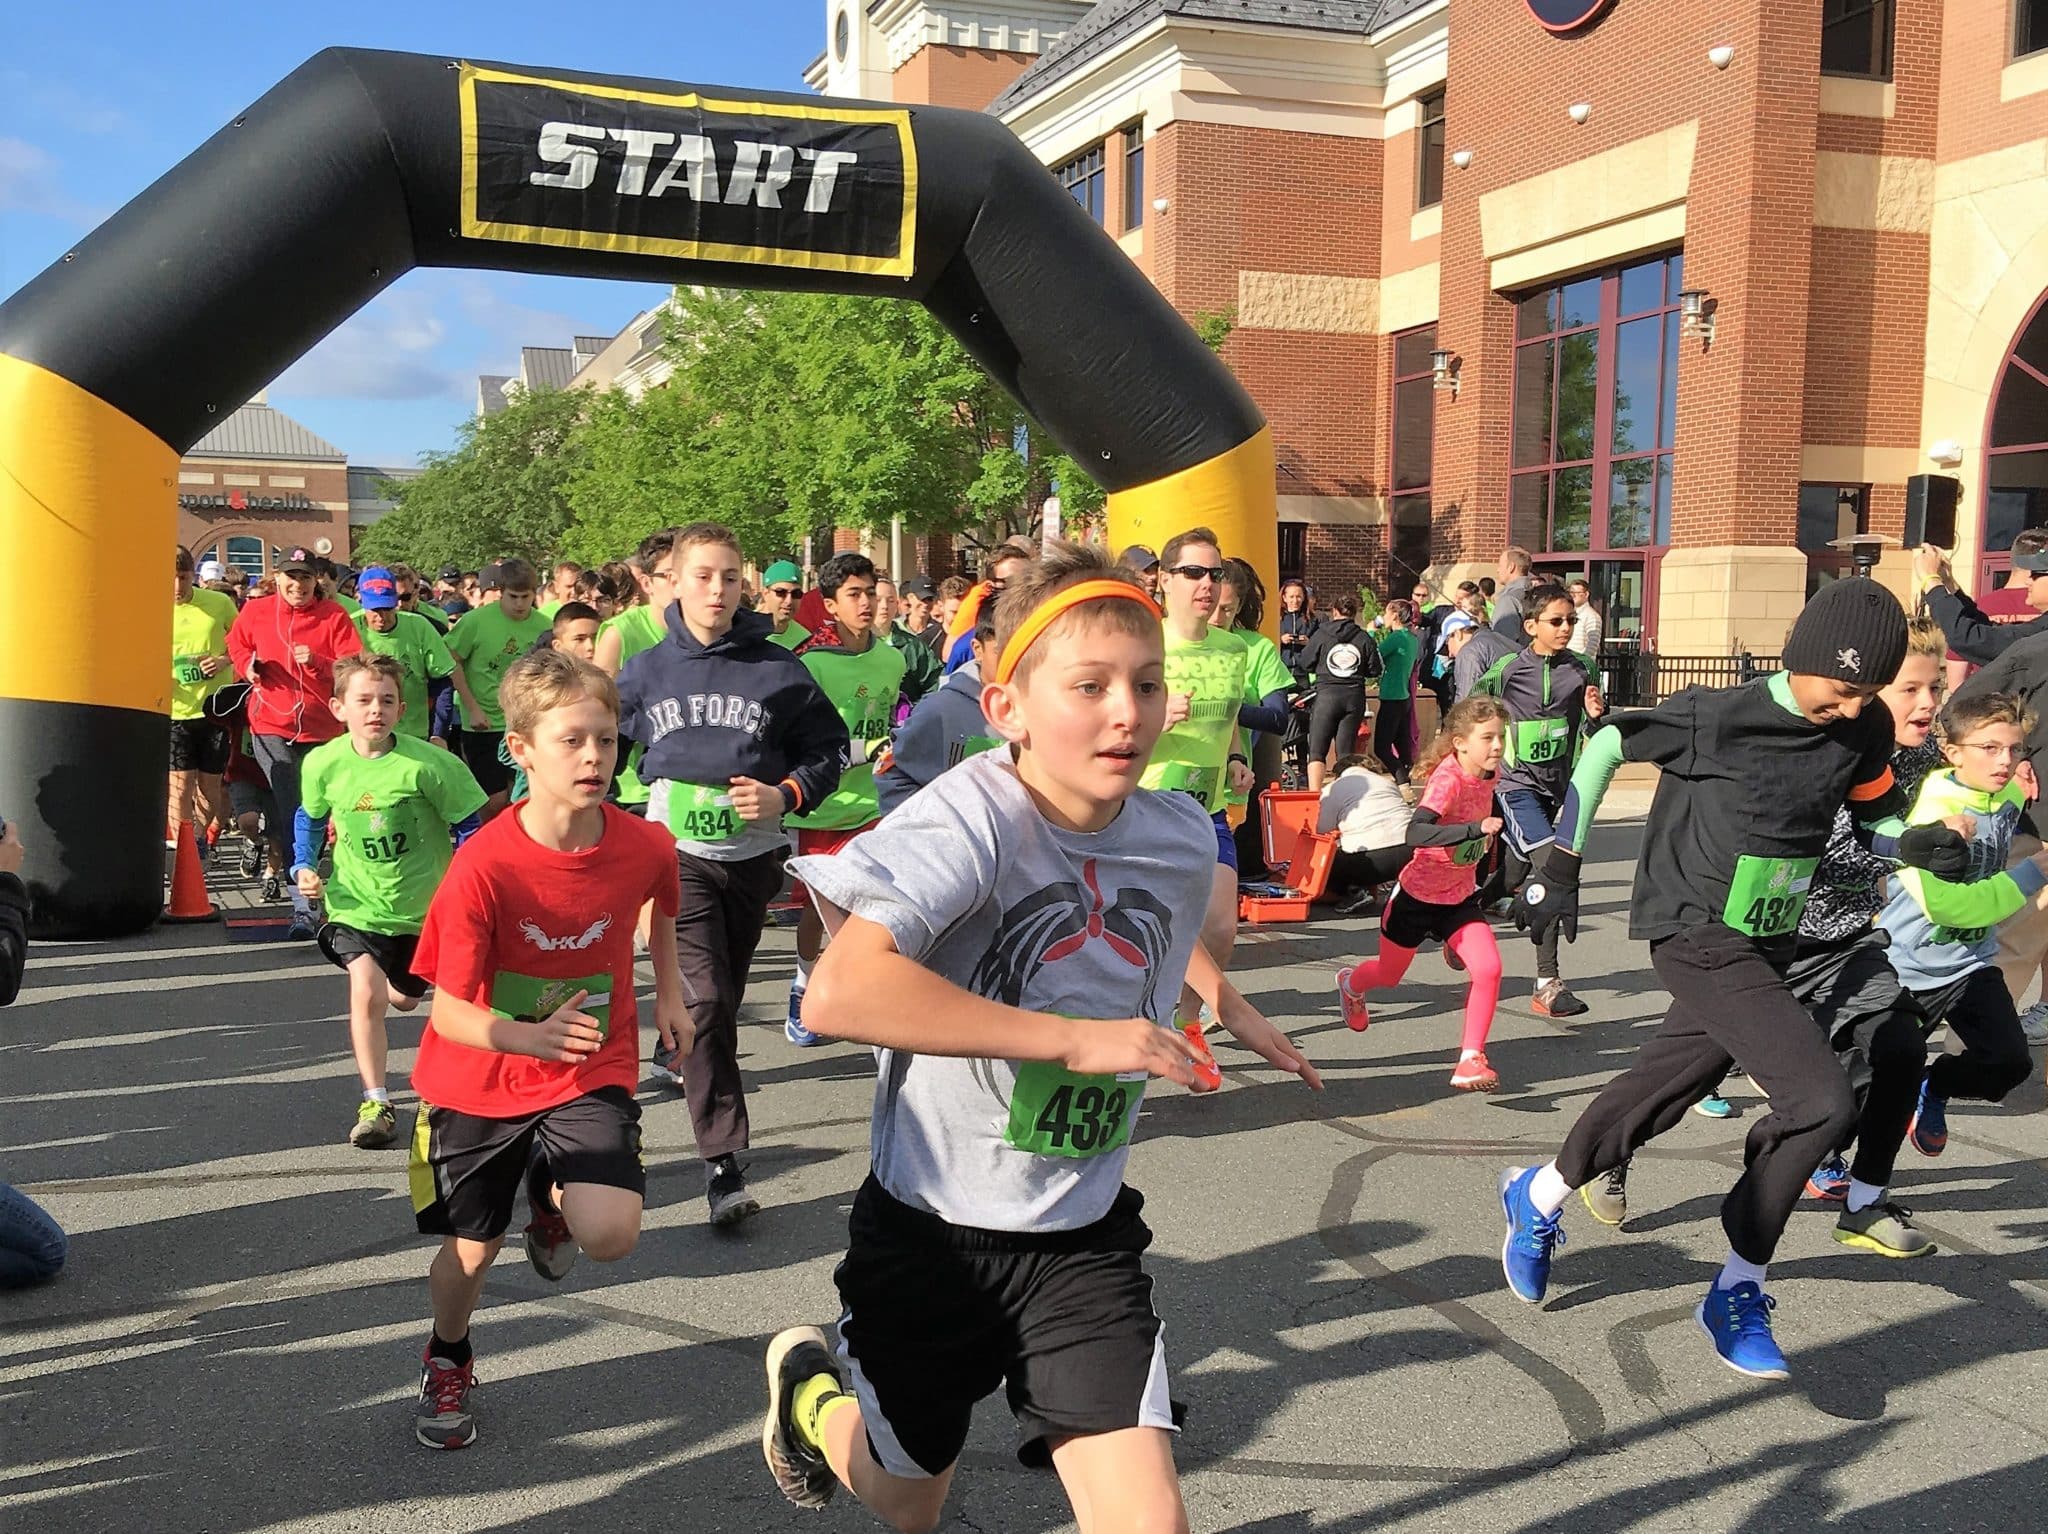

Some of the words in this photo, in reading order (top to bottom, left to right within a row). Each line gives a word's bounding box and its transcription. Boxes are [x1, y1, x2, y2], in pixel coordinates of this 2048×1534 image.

[530, 121, 858, 213] START
[687, 693, 774, 741] FORCE
[1529, 738, 1562, 760] 397
[683, 808, 734, 837] 434
[361, 832, 409, 860] 512
[1742, 896, 1798, 933] 432
[1036, 1084, 1127, 1151] 433
